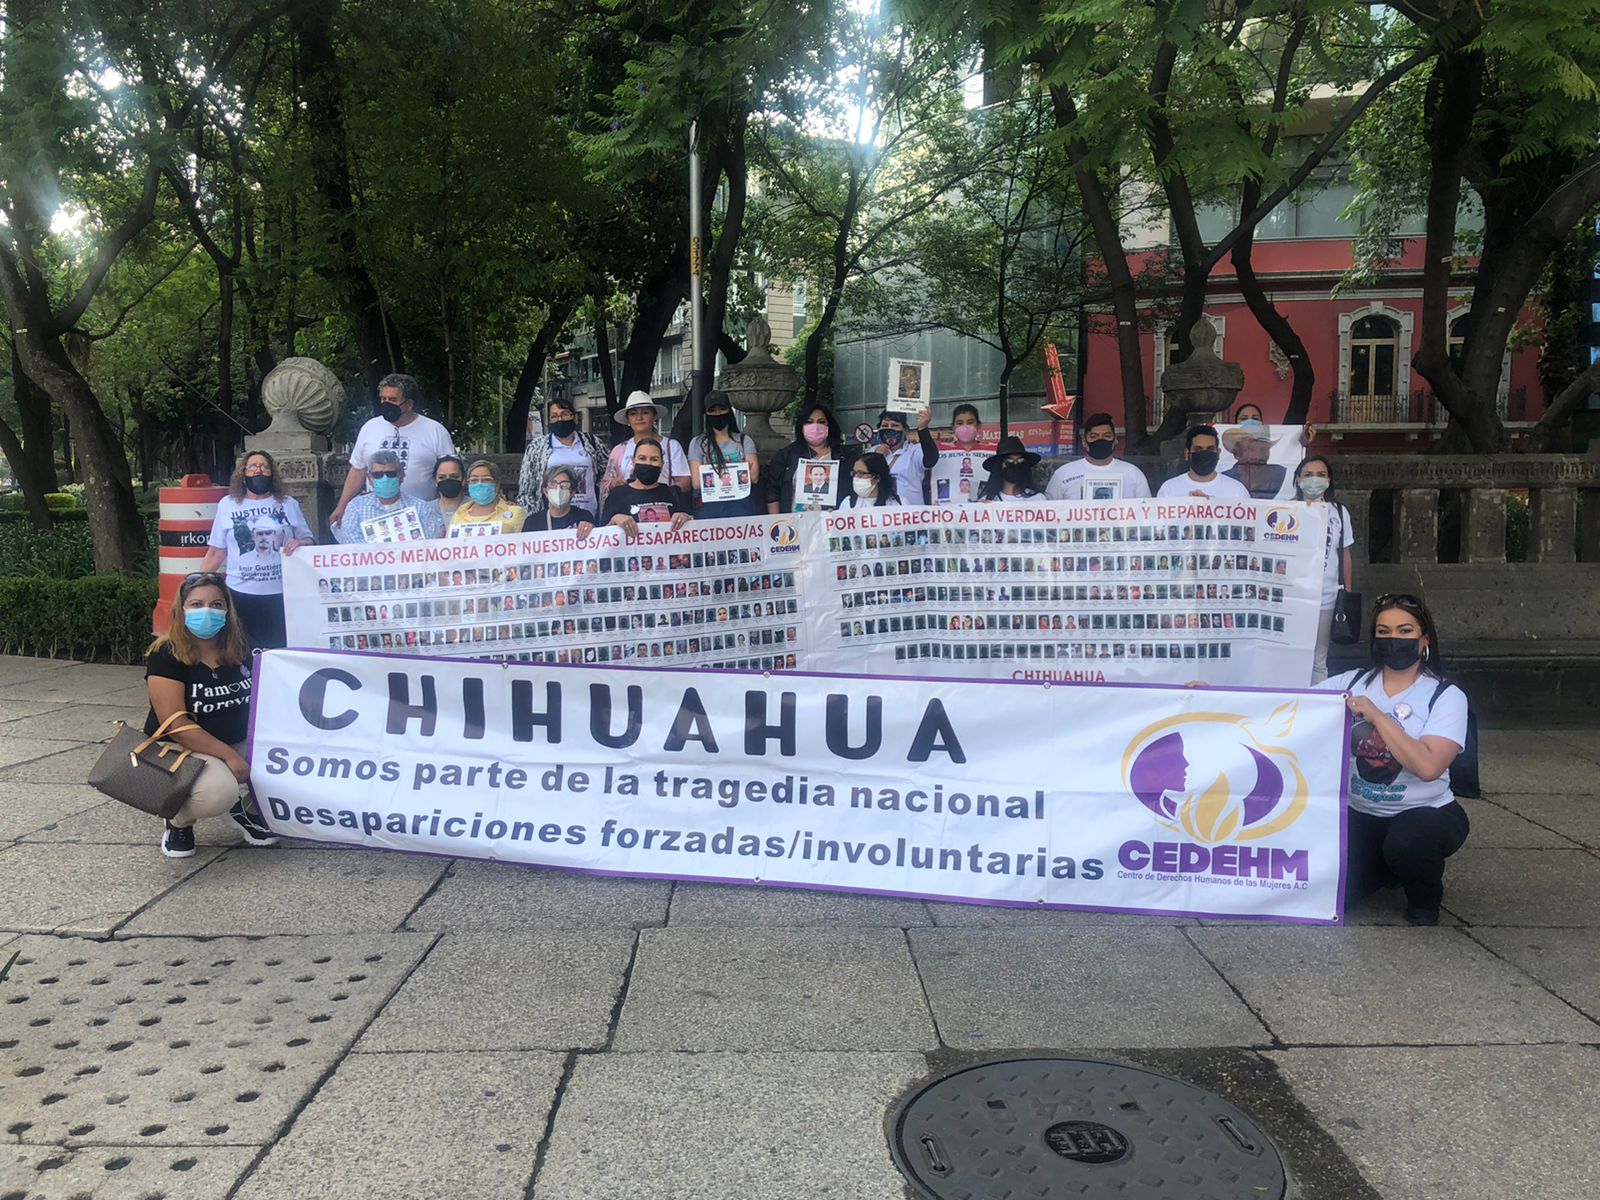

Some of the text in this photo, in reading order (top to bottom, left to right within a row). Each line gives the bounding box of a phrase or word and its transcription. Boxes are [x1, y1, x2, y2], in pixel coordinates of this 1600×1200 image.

[825, 502, 1257, 532] POR EL DERECHO A LA VERDAD, JUSTICIA Y REPARACIÓN
[312, 523, 764, 569] ELEGIMOS MEMORIA POR NUESTROS/AS DESAPARECIDOS/AS
[1012, 669, 1105, 682] CHIHUAHUA
[298, 667, 967, 764] CHIHUAHUA
[265, 746, 1046, 820] Somos parte de la tragedia nacional
[267, 796, 1105, 881] Desapariciones forzadas/involuntarias
[1117, 840, 1309, 881] CEDEHM
[1117, 870, 1144, 880] Centro
[1145, 872, 1155, 881] de
[1156, 872, 1193, 883] Derechos
[1194, 875, 1232, 886] Humanos
[1233, 877, 1244, 887] de
[1245, 879, 1258, 888] las
[1259, 879, 1292, 890] Mujeres
